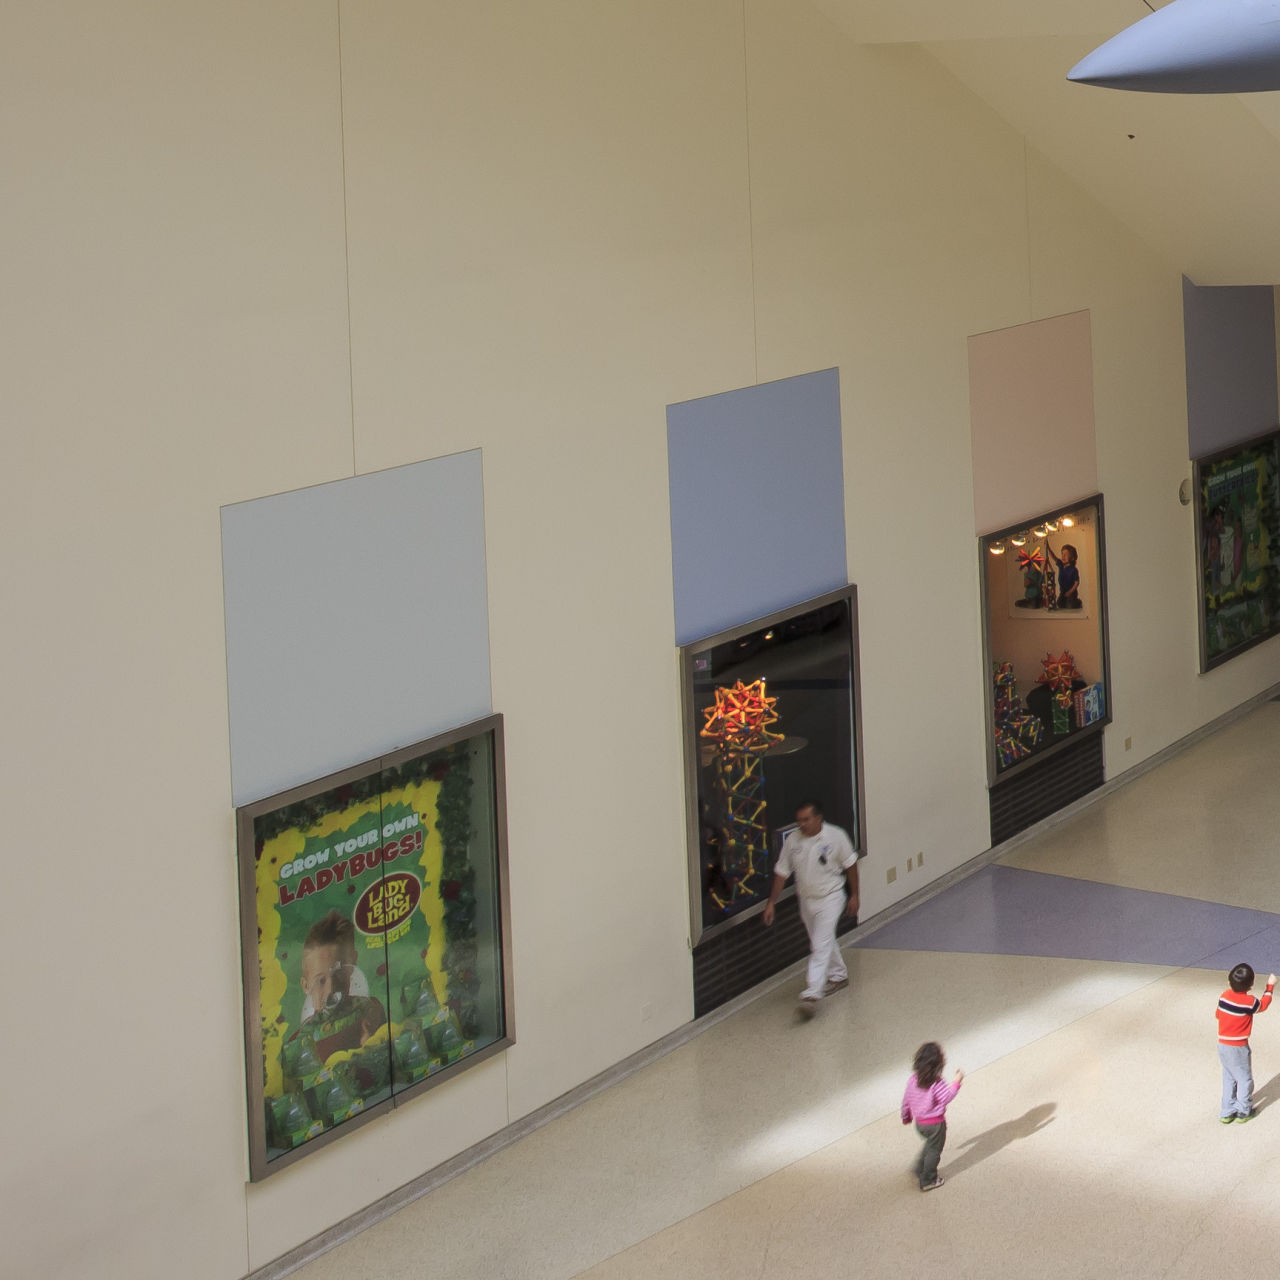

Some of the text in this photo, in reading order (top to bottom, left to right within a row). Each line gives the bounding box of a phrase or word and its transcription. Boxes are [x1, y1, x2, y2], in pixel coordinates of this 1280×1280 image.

[280, 813, 419, 879] GROW YOUR OWN
[279, 830, 423, 907] LADYBUGS!
[368, 879, 410, 908] LADY
[373, 893, 404, 919] BUG
[367, 894, 411, 929] Land
